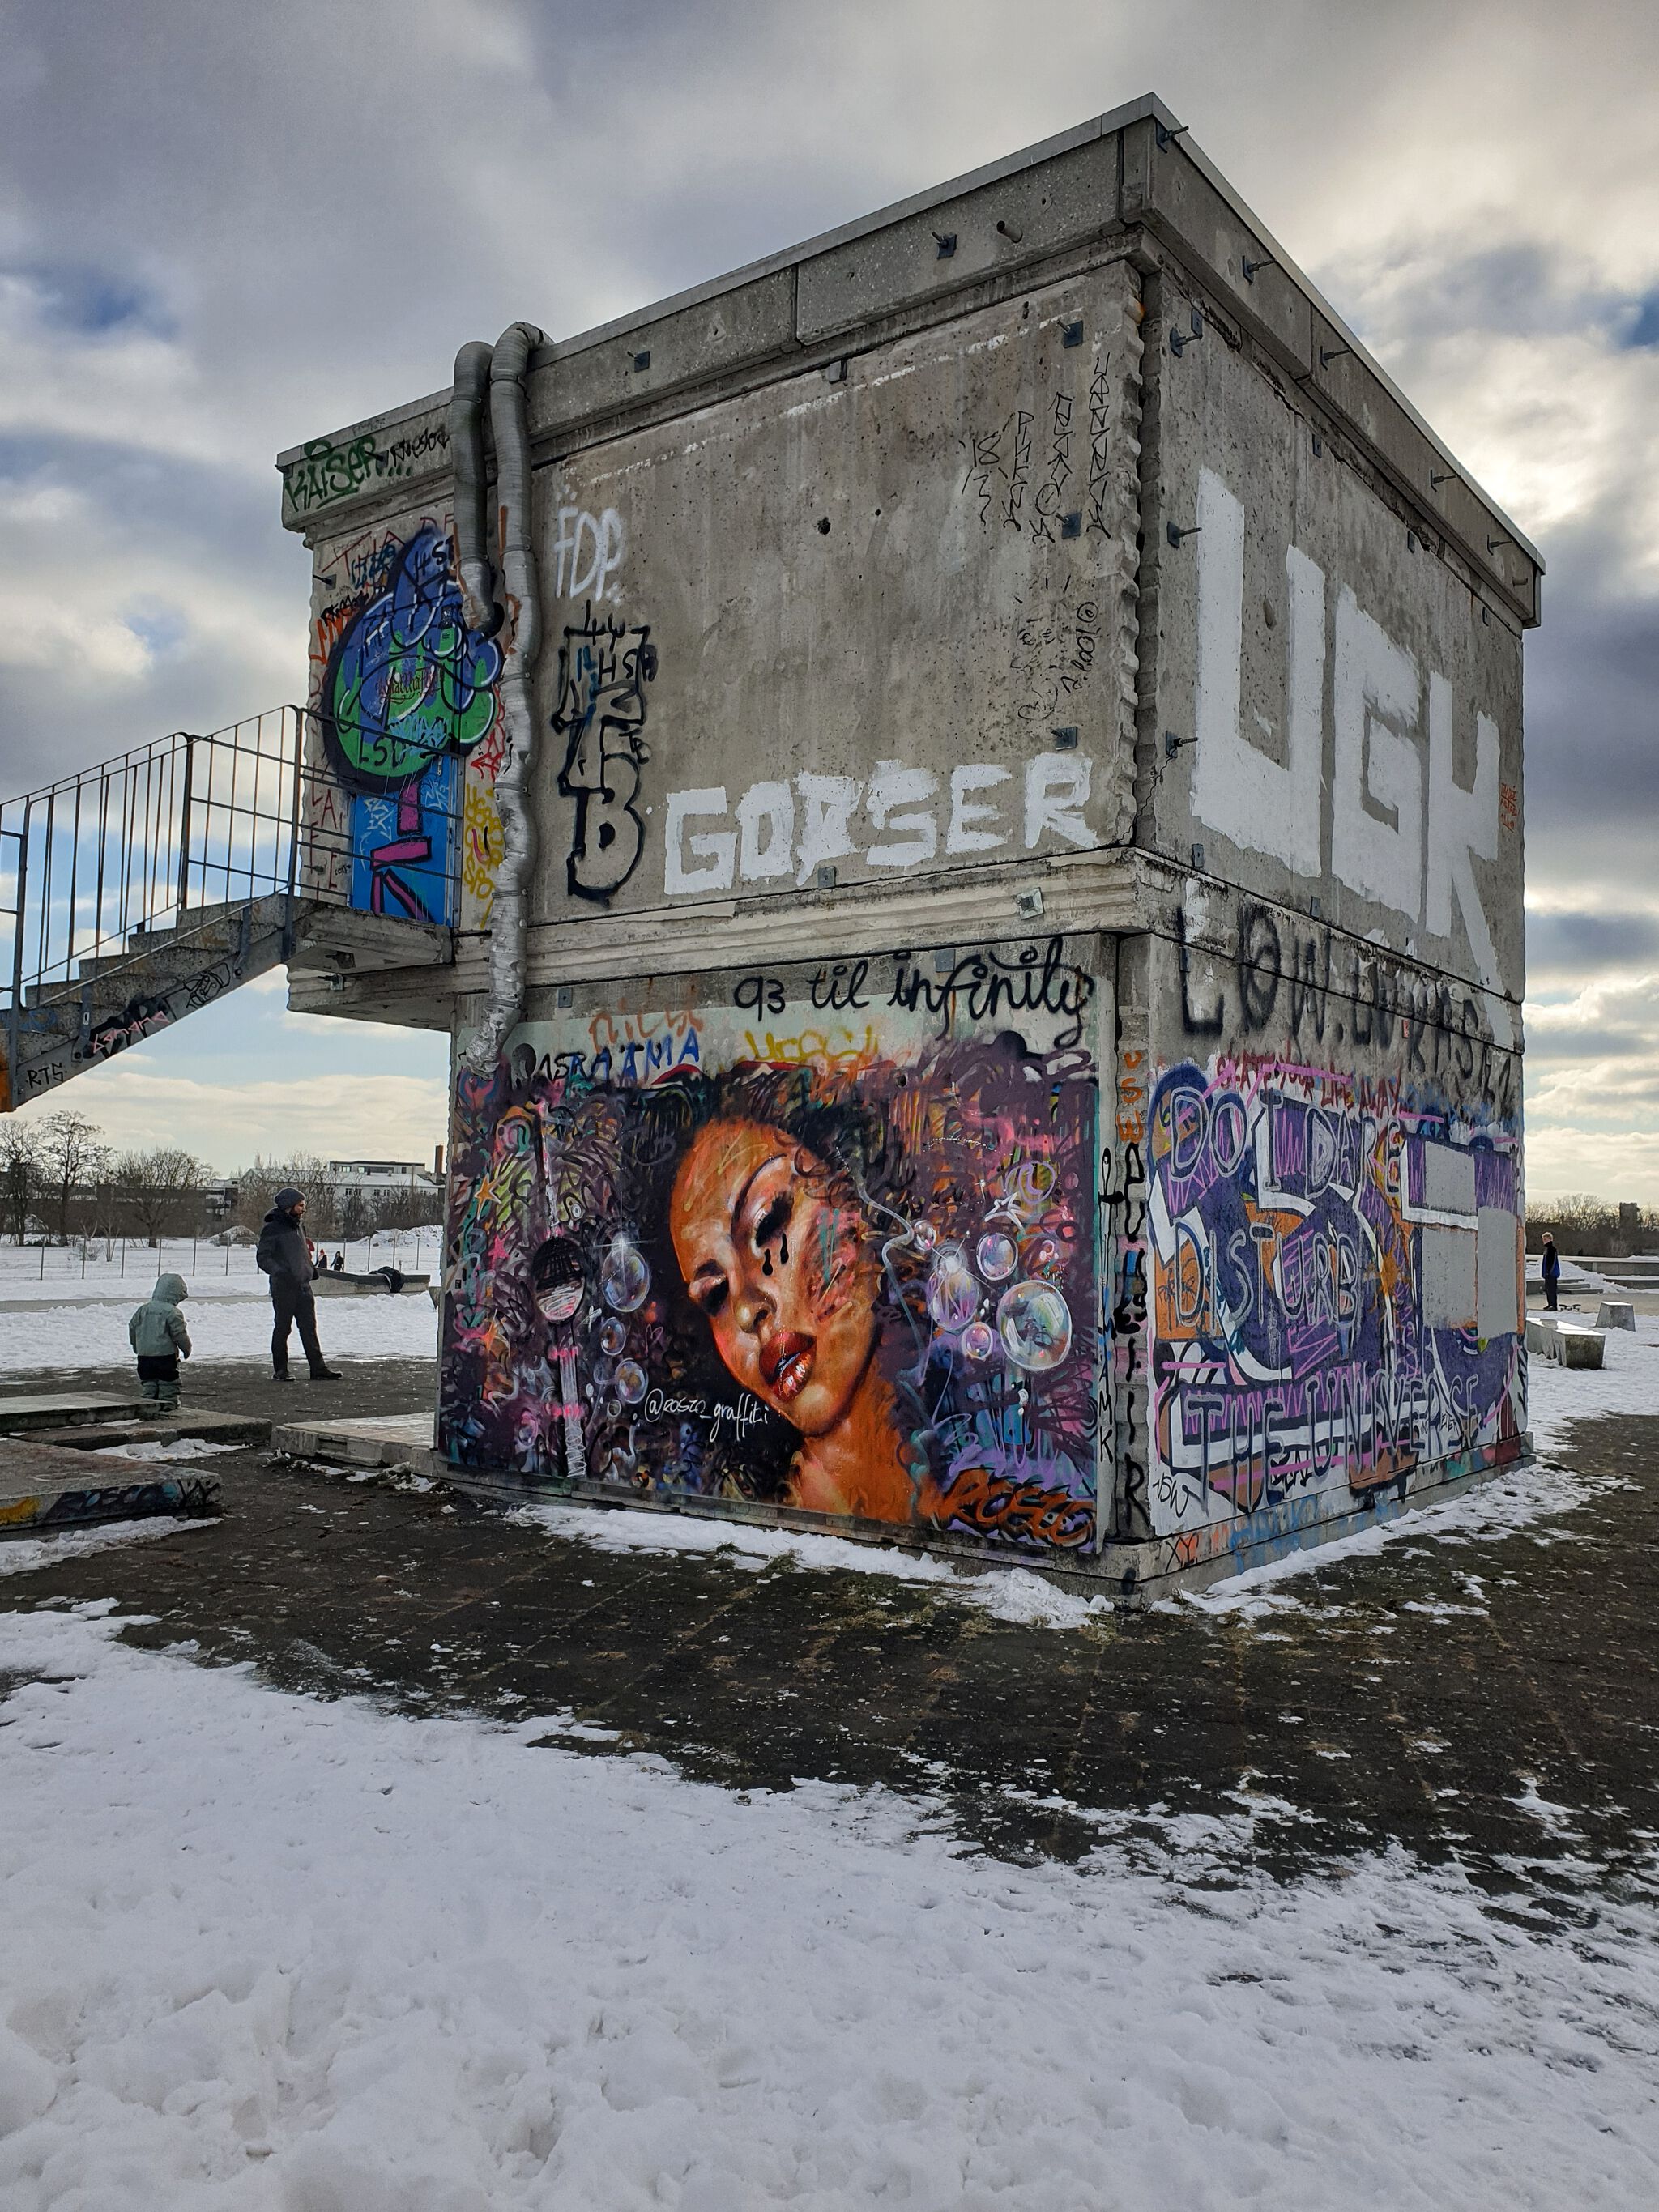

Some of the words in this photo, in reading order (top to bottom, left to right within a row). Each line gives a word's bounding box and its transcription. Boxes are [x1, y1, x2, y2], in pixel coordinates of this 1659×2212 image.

[734, 977, 786, 1021] 93
[808, 959, 870, 1010] til
[1170, 1086, 1247, 1183] DO
[1256, 1088, 1283, 1192] I
[1304, 1105, 1405, 1200] DARE
[1175, 1217, 1361, 1330] DISTURB
[1185, 1392, 1286, 1516] THE
[1304, 1366, 1479, 1481] UNIVERSE
